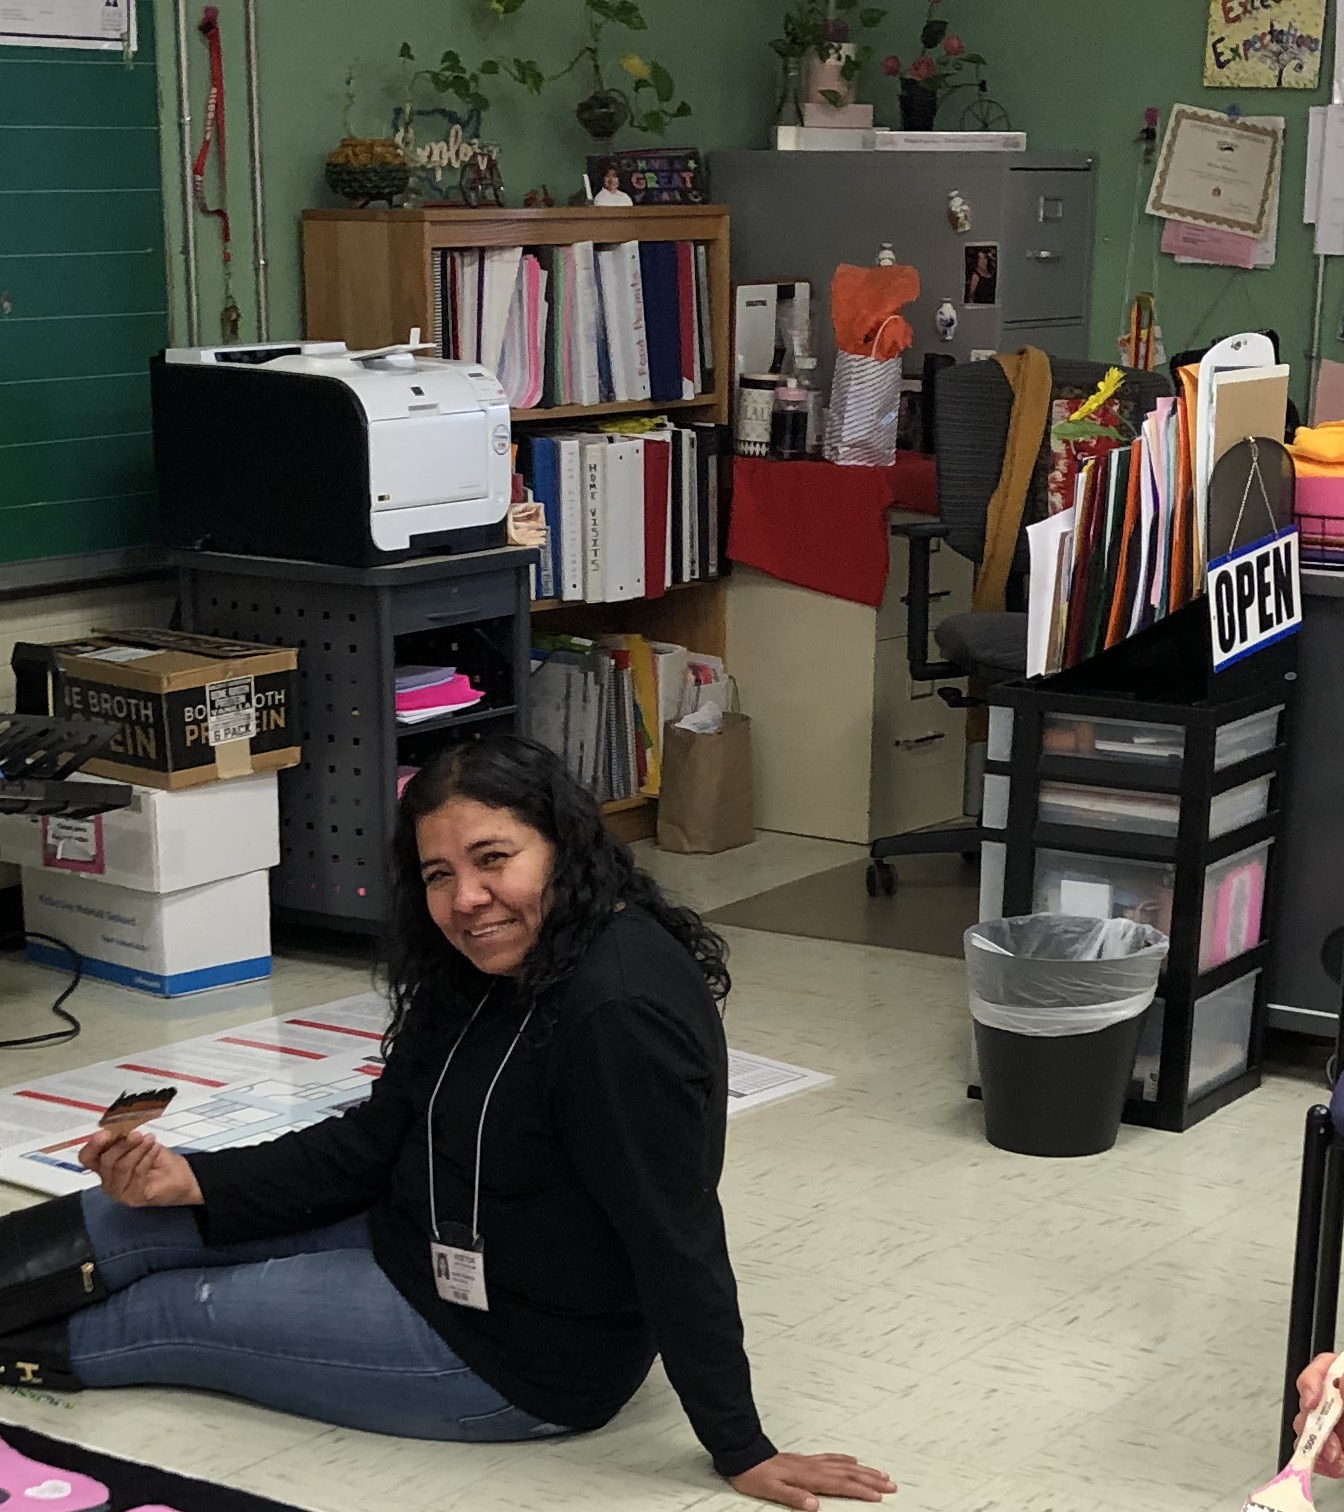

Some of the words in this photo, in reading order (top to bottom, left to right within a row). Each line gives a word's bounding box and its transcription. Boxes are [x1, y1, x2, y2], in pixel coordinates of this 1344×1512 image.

[588, 463, 598, 500] HOME
[589, 508, 600, 573] VISITS
[1215, 541, 1295, 654] OPEN
[87, 690, 154, 724] BROTH
[224, 723, 253, 741] PACK
